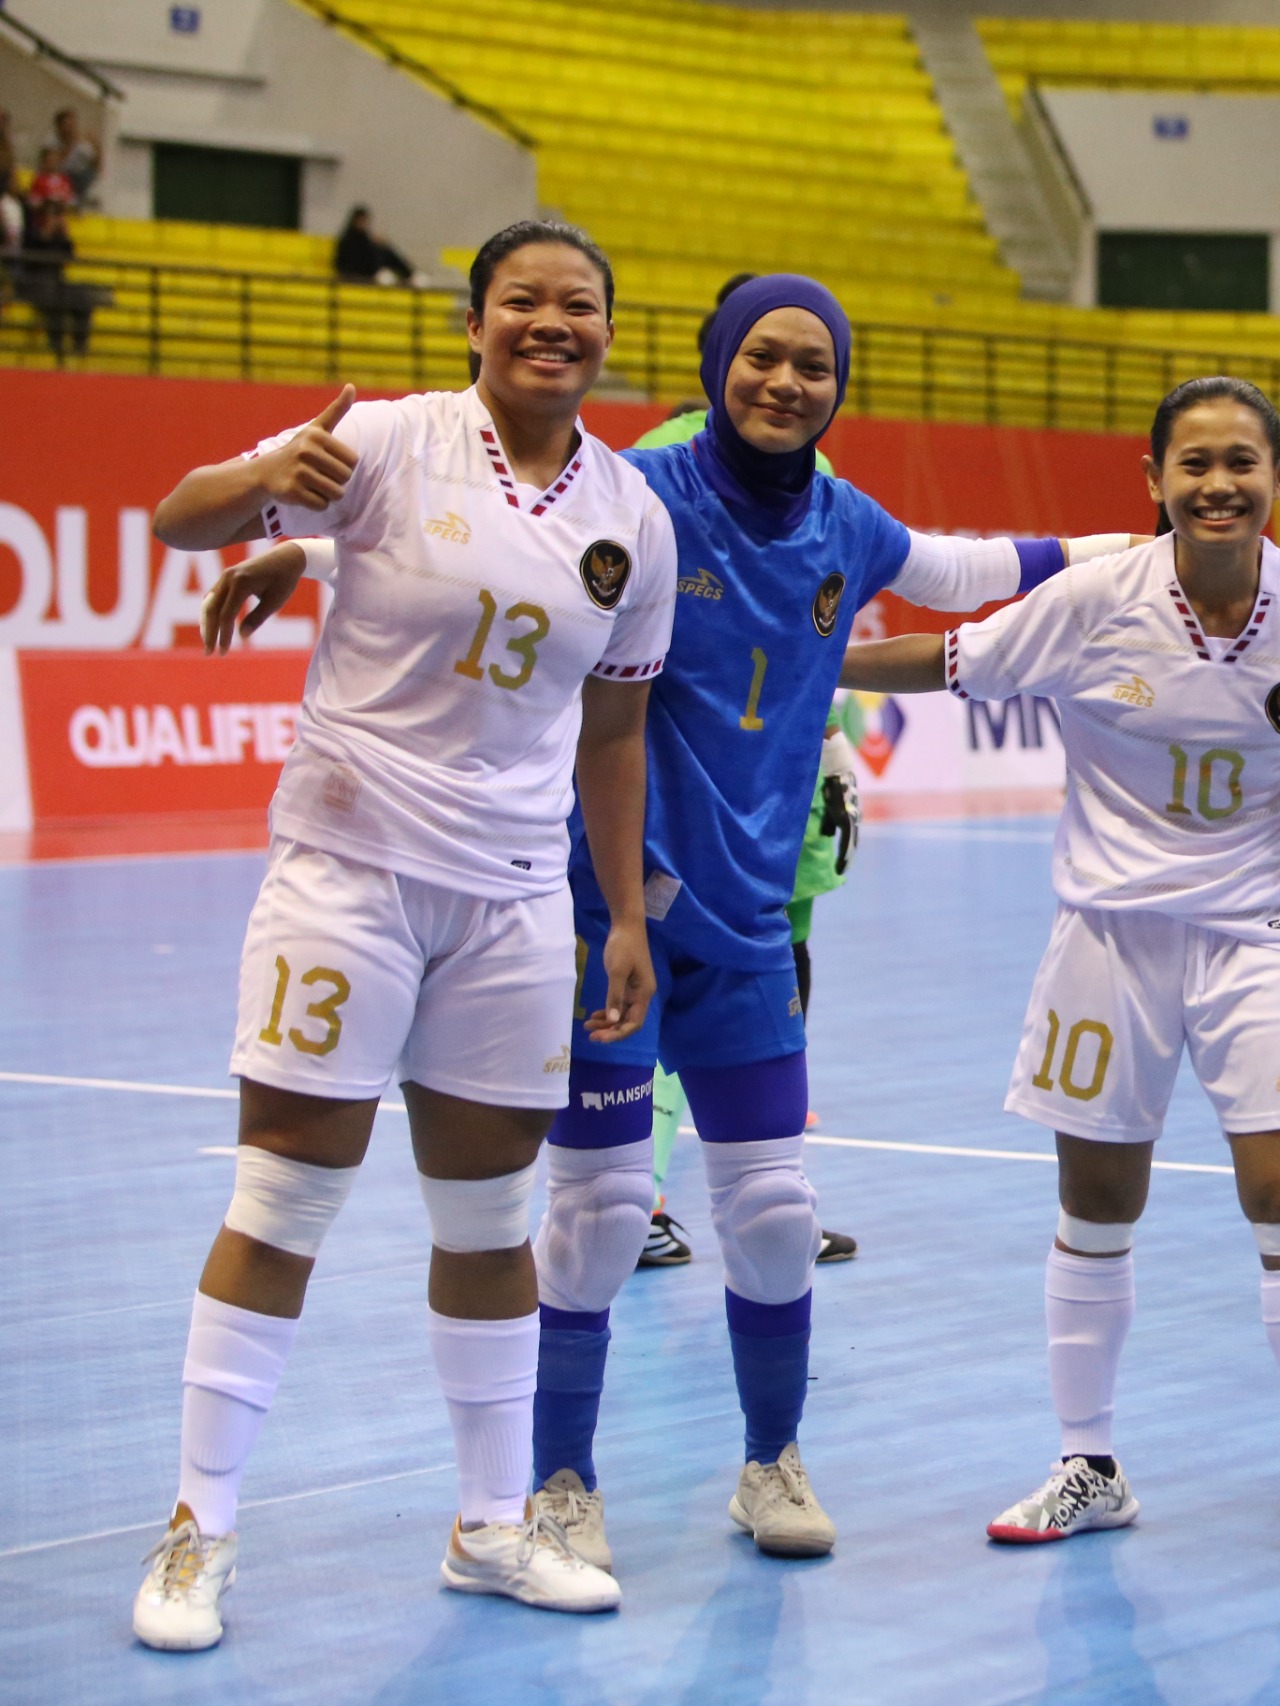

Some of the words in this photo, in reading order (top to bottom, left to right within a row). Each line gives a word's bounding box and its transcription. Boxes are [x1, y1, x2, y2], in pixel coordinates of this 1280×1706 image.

[677, 580, 723, 600] SPECS
[453, 588, 550, 690] 13
[739, 647, 768, 730] 1
[1112, 687, 1154, 708] SPECS
[1165, 743, 1246, 821] 10
[258, 956, 350, 1056] 13
[1031, 1009, 1114, 1101] 10
